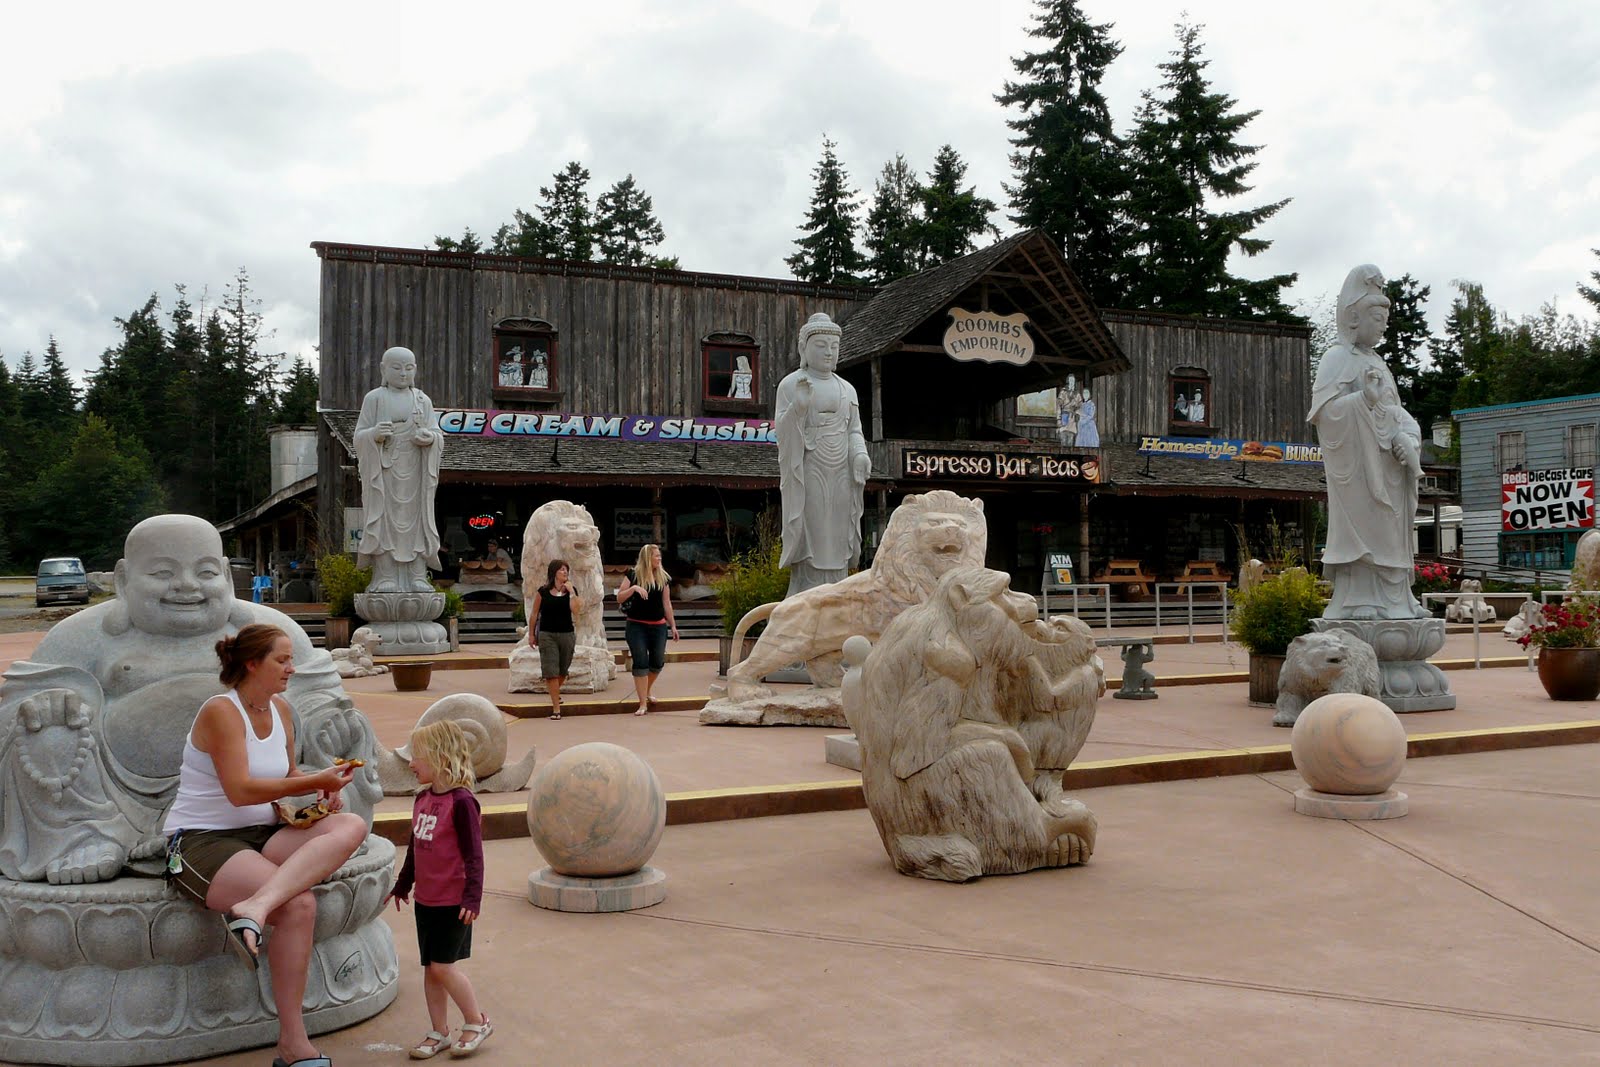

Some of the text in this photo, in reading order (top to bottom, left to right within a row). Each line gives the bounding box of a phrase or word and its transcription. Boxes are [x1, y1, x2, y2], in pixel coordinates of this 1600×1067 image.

[956, 318, 1021, 338] COOMBS
[950, 336, 1027, 359] EMPORIUM
[490, 413, 626, 438] CREAM
[632, 418, 655, 434] &
[1139, 437, 1238, 459] Homestyle
[906, 451, 992, 477] Espresso
[995, 453, 1032, 479] Bar
[1036, 455, 1080, 477] Teas
[1502, 468, 1593, 485] Reds DieCast Cars
[1516, 481, 1573, 504] NOW
[469, 517, 495, 527] OPEN
[1509, 499, 1587, 530] OPEN
[1050, 554, 1072, 565] ATM
[413, 813, 438, 841] 02
